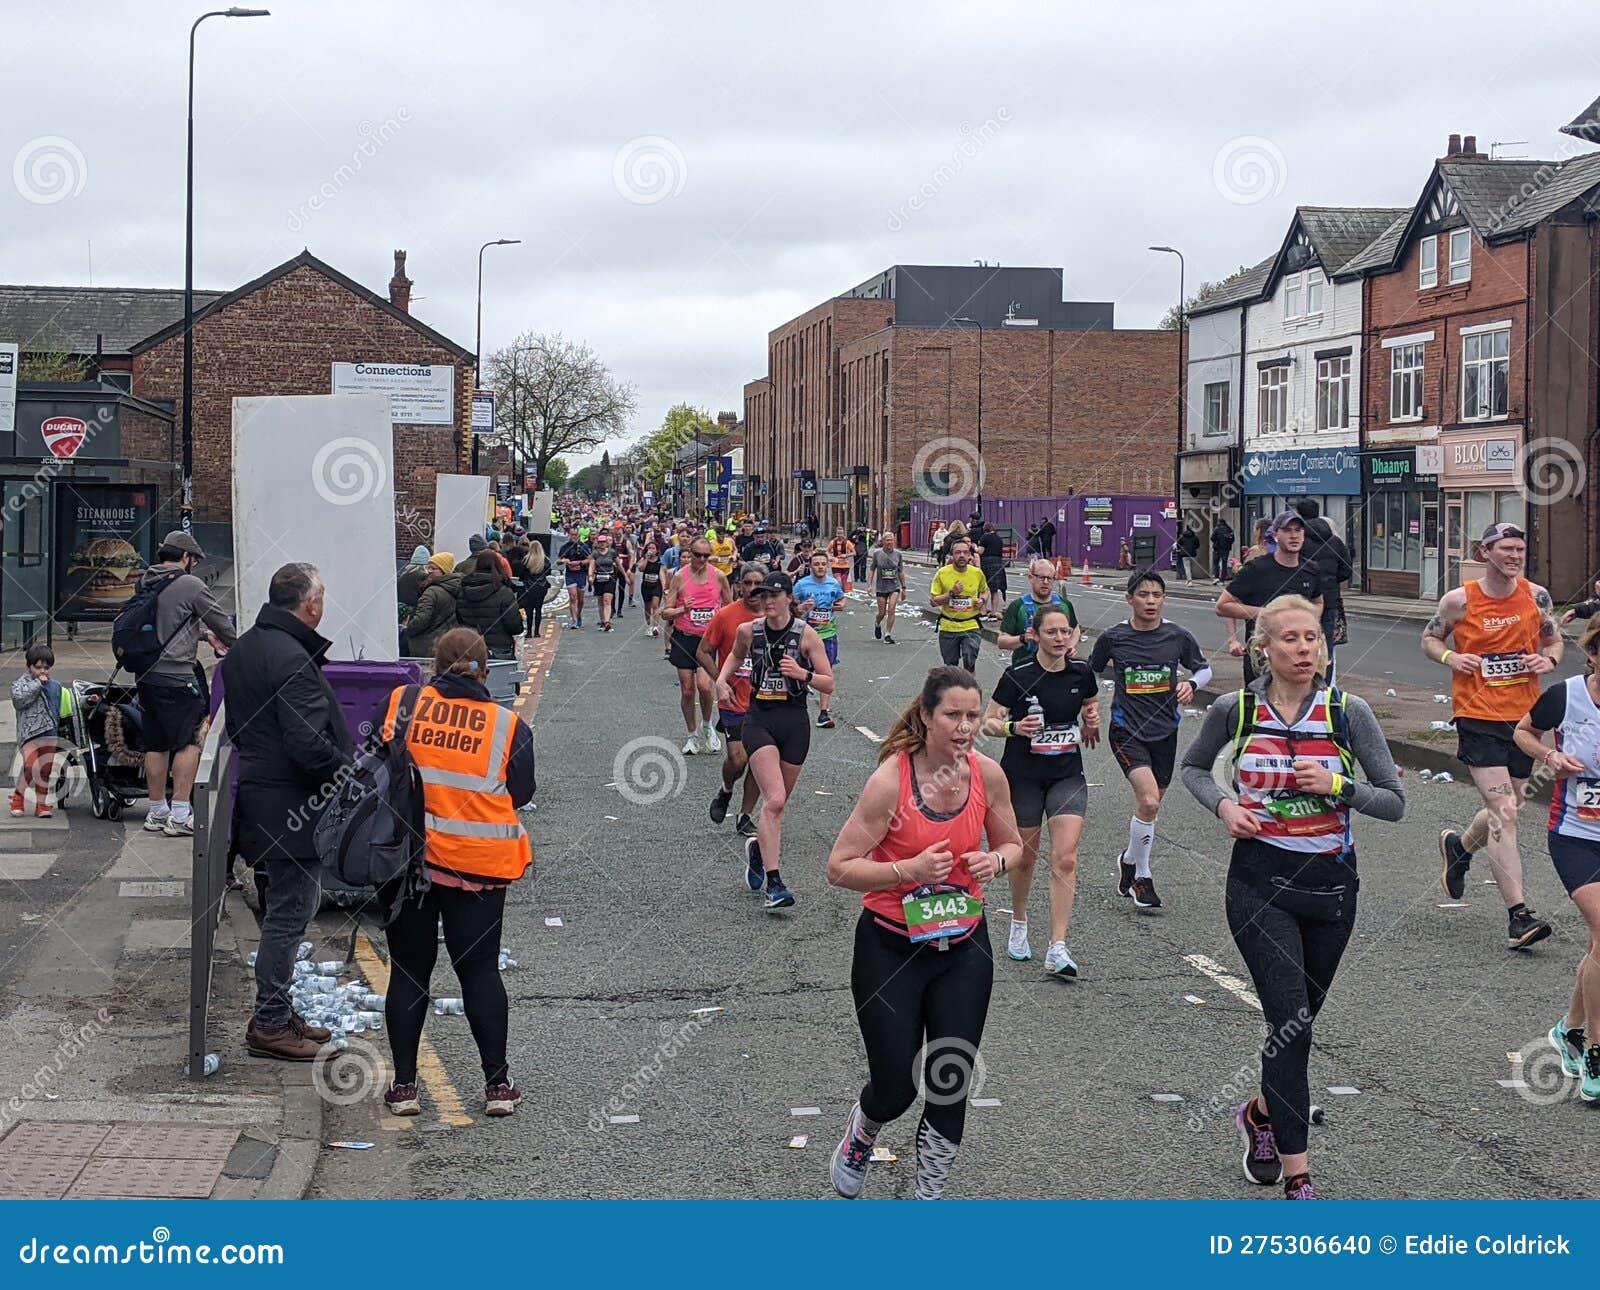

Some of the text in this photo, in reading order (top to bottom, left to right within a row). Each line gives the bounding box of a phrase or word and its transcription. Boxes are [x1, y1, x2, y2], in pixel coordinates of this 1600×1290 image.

[355, 364, 432, 377] Connections
[46, 423, 82, 431] DUCATI
[1261, 451, 1357, 476] Manchester Cosmetics Clinic
[1372, 458, 1410, 477] Dhaanya
[77, 507, 136, 520] STEAKHOUSE
[1135, 673, 1162, 683] 2309
[415, 696, 486, 732] Zone
[411, 723, 482, 754] Leader
[1036, 732, 1076, 743] 22472
[1280, 759, 1297, 768] PAR
[920, 896, 968, 920] 3443
